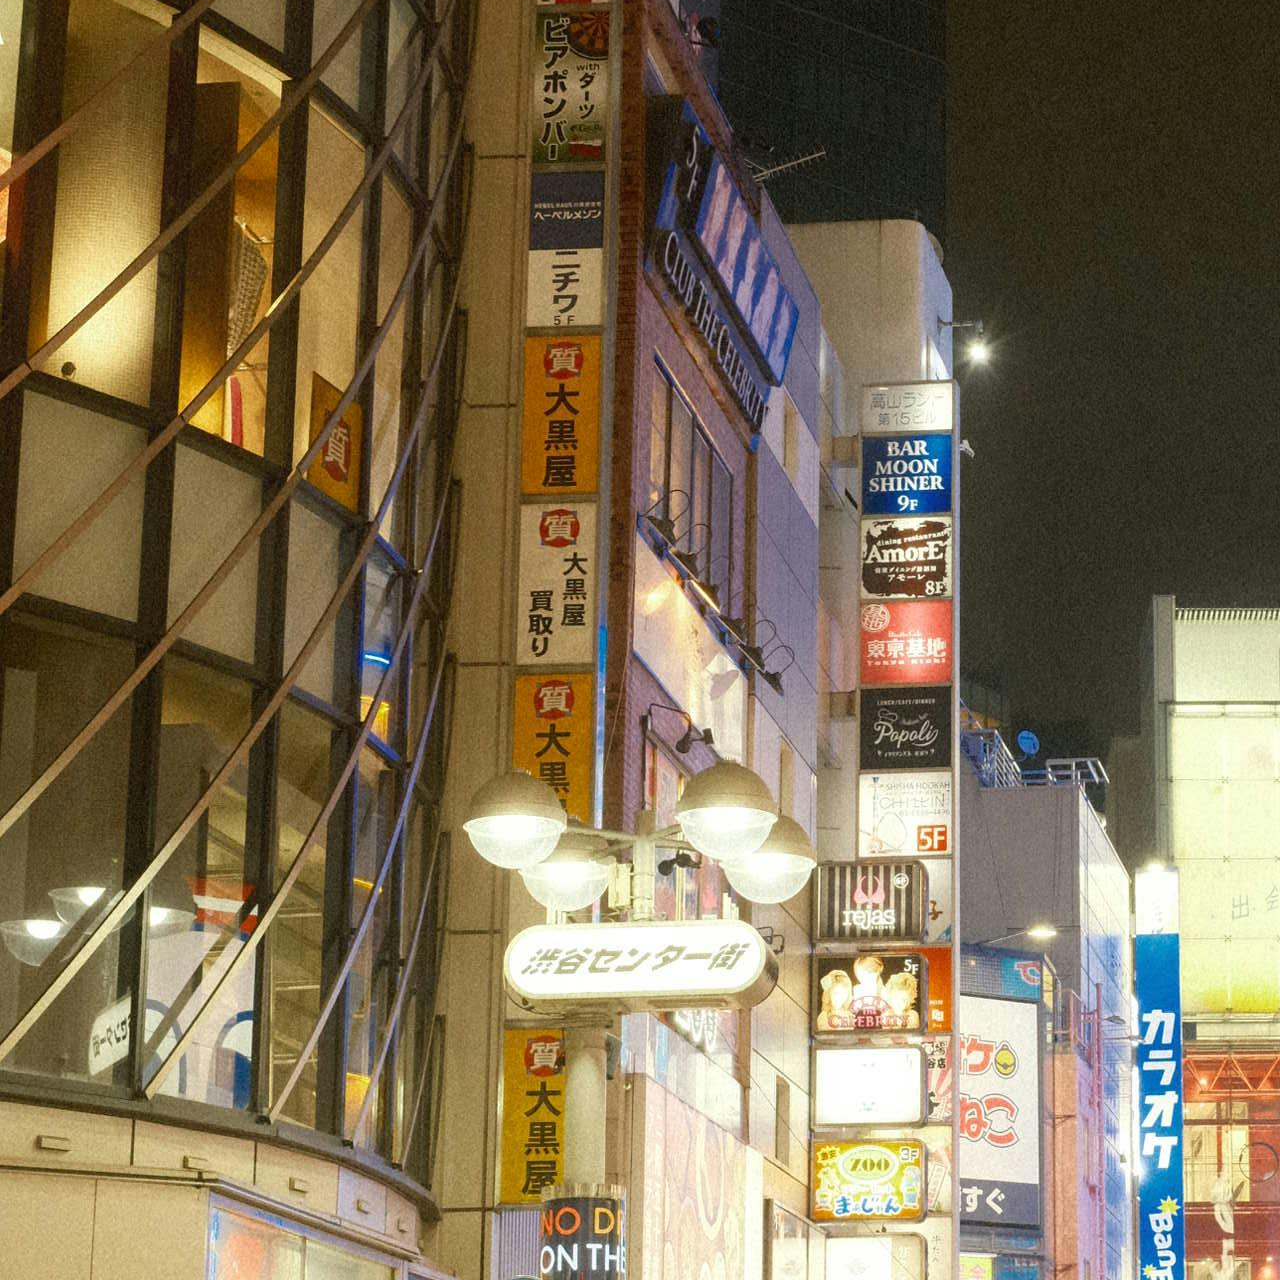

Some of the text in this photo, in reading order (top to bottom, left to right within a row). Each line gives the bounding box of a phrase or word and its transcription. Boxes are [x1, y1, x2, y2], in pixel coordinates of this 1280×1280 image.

[576, 63, 600, 72] with
[541, 17, 570, 162] ビアポンバー
[577, 72, 596, 120] ダーツ
[551, 251, 581, 314] ニチワ
[552, 315, 576, 326] 5F
[549, 347, 580, 373] 質
[542, 384, 580, 487] 大黒屋
[887, 440, 929, 457] BAR
[875, 458, 939, 475] MOON
[869, 476, 944, 492] SHINER
[897, 495, 918, 511] 9F
[546, 515, 575, 540] 質
[561, 553, 588, 626] 大黒屋
[925, 581, 945, 595] 8F
[528, 591, 553, 656] 買取り
[539, 686, 569, 711] 質
[874, 719, 939, 748] Popoli
[919, 827, 945, 849] 5F
[842, 904, 896, 930] rejas
[521, 943, 749, 976] 渋谷センター街
[904, 959, 919, 974] 5F
[1142, 1009, 1179, 1168] カラオケ
[521, 1082, 562, 1195] 大黒屋
[541, 1206, 581, 1237] NO
[540, 1243, 579, 1274] ON
